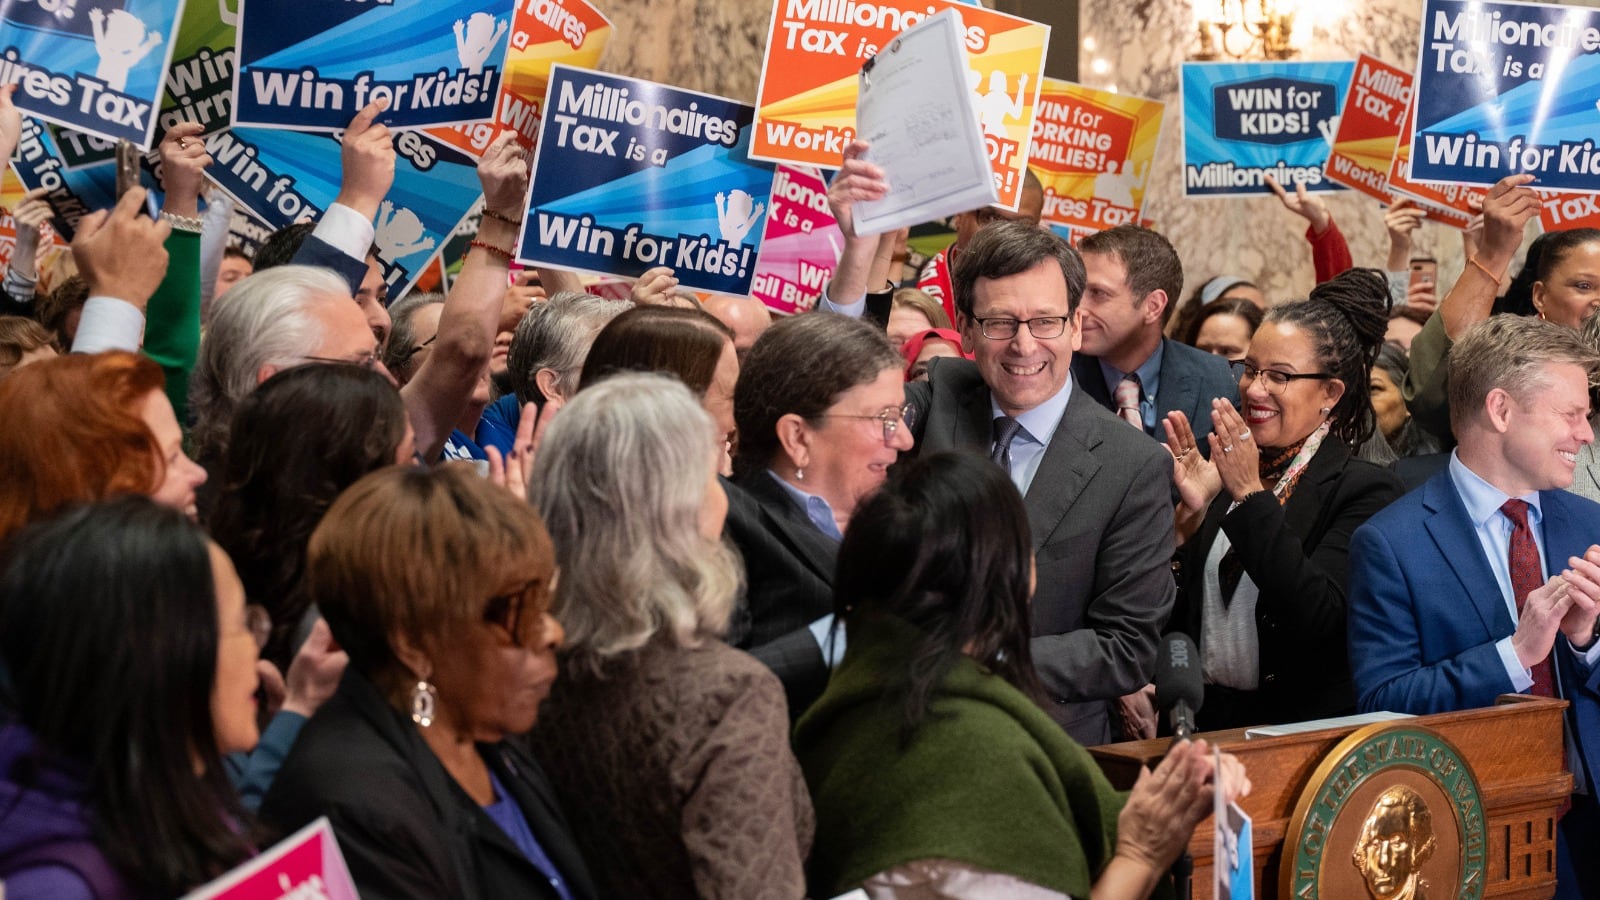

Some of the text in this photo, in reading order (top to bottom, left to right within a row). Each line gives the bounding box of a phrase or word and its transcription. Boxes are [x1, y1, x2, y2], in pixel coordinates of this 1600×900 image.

[512, 31, 529, 49] a
[783, 21, 878, 59] Tax is
[166, 50, 235, 97] Win
[1503, 55, 1522, 77] is
[1528, 63, 1544, 79] a
[76, 77, 149, 131] Tax
[252, 70, 492, 111] Win for Kids!
[1228, 86, 1321, 110] WIN for
[1354, 85, 1393, 122] Tax
[501, 93, 541, 143] Win
[558, 80, 737, 145] Millionaires
[1073, 107, 1102, 129] for
[1240, 111, 1310, 134] KIDS!
[554, 114, 668, 166] Tax is a
[766, 122, 857, 154] Worki
[1425, 134, 1499, 168] Win
[1508, 138, 1554, 172] for
[205, 132, 268, 192] Win
[265, 177, 317, 224] for
[1187, 161, 1322, 188] Millionaires
[783, 208, 799, 228] is
[801, 219, 813, 233] a
[1092, 200, 1136, 226] Tax
[1543, 193, 1600, 225] Tax
[538, 213, 751, 278] Win for Kids!
[1304, 811, 1328, 856] OF
[1320, 756, 1363, 811] THE
[1362, 736, 1427, 771] STATE
[1430, 746, 1457, 776] OF
